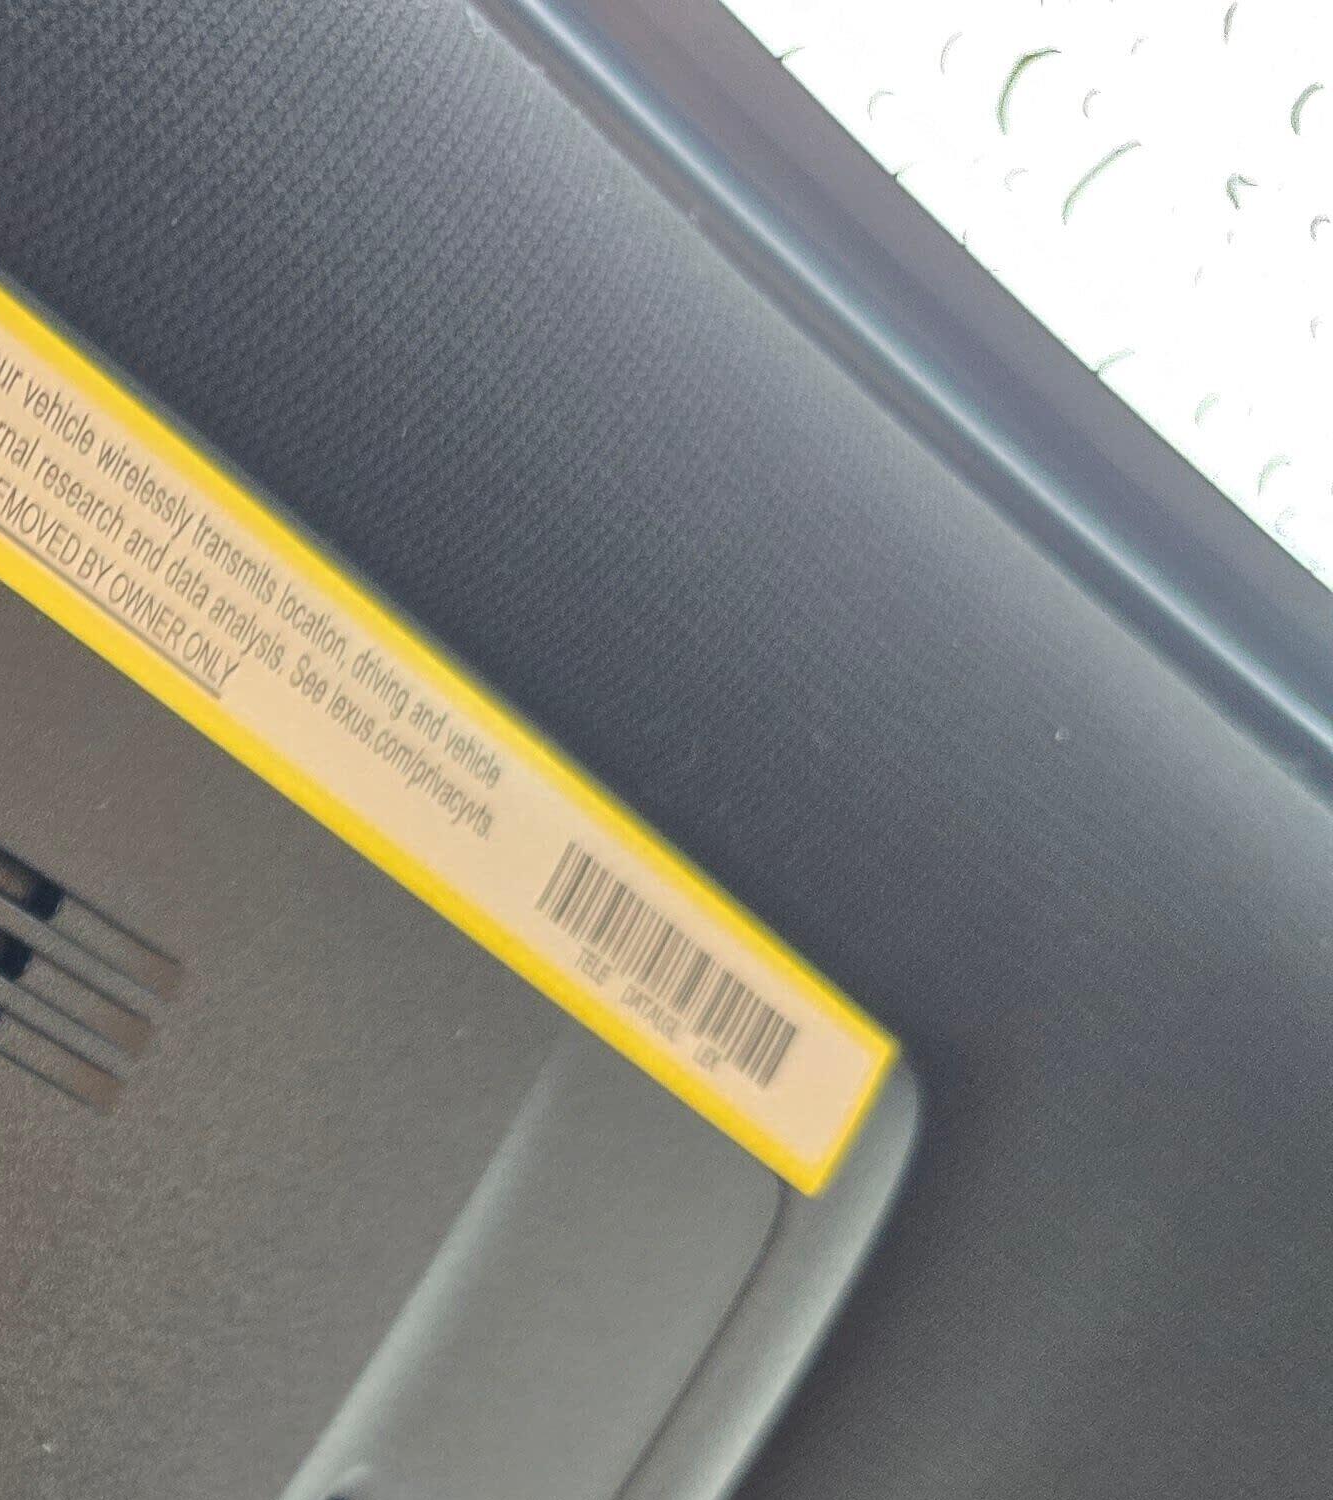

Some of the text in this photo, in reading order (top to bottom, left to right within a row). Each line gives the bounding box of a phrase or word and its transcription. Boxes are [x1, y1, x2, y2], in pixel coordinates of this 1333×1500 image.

[22, 378, 96, 457] vehicle
[96, 438, 194, 541] wirelessly
[191, 513, 278, 606] transmits
[275, 581, 347, 670] location,
[351, 649, 411, 721] driving
[409, 700, 448, 743] and
[444, 728, 501, 790] vehicle
[33, 454, 125, 544] research
[122, 527, 170, 575] and
[163, 555, 211, 612] data
[207, 595, 287, 676] analysis.
[289, 652, 329, 705] See
[76, 546, 114, 589] BY
[107, 572, 187, 651] OWNER
[181, 630, 240, 688] ONLY
